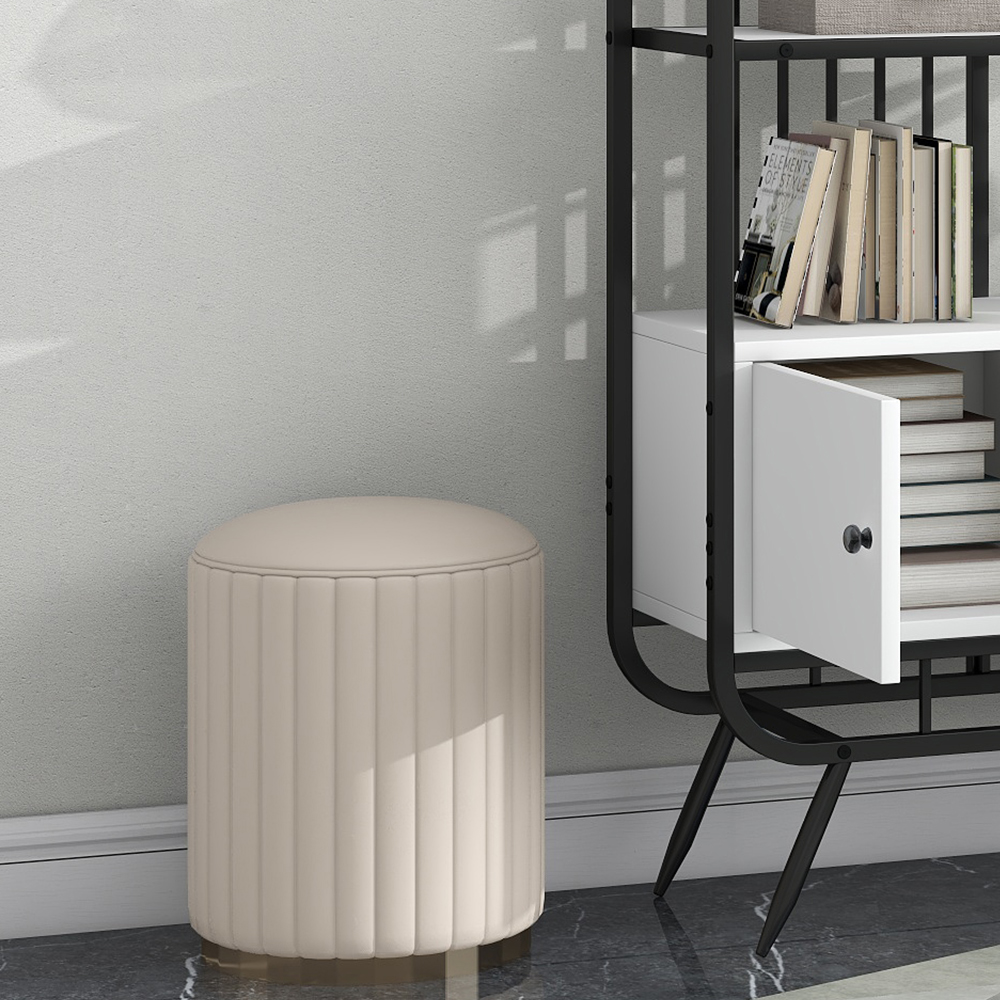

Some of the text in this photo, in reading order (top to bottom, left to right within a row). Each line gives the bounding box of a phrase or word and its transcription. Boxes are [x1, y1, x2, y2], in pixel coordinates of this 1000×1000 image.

[768, 152, 813, 176] ELEMENTS
[764, 170, 809, 193] OF STYLE
